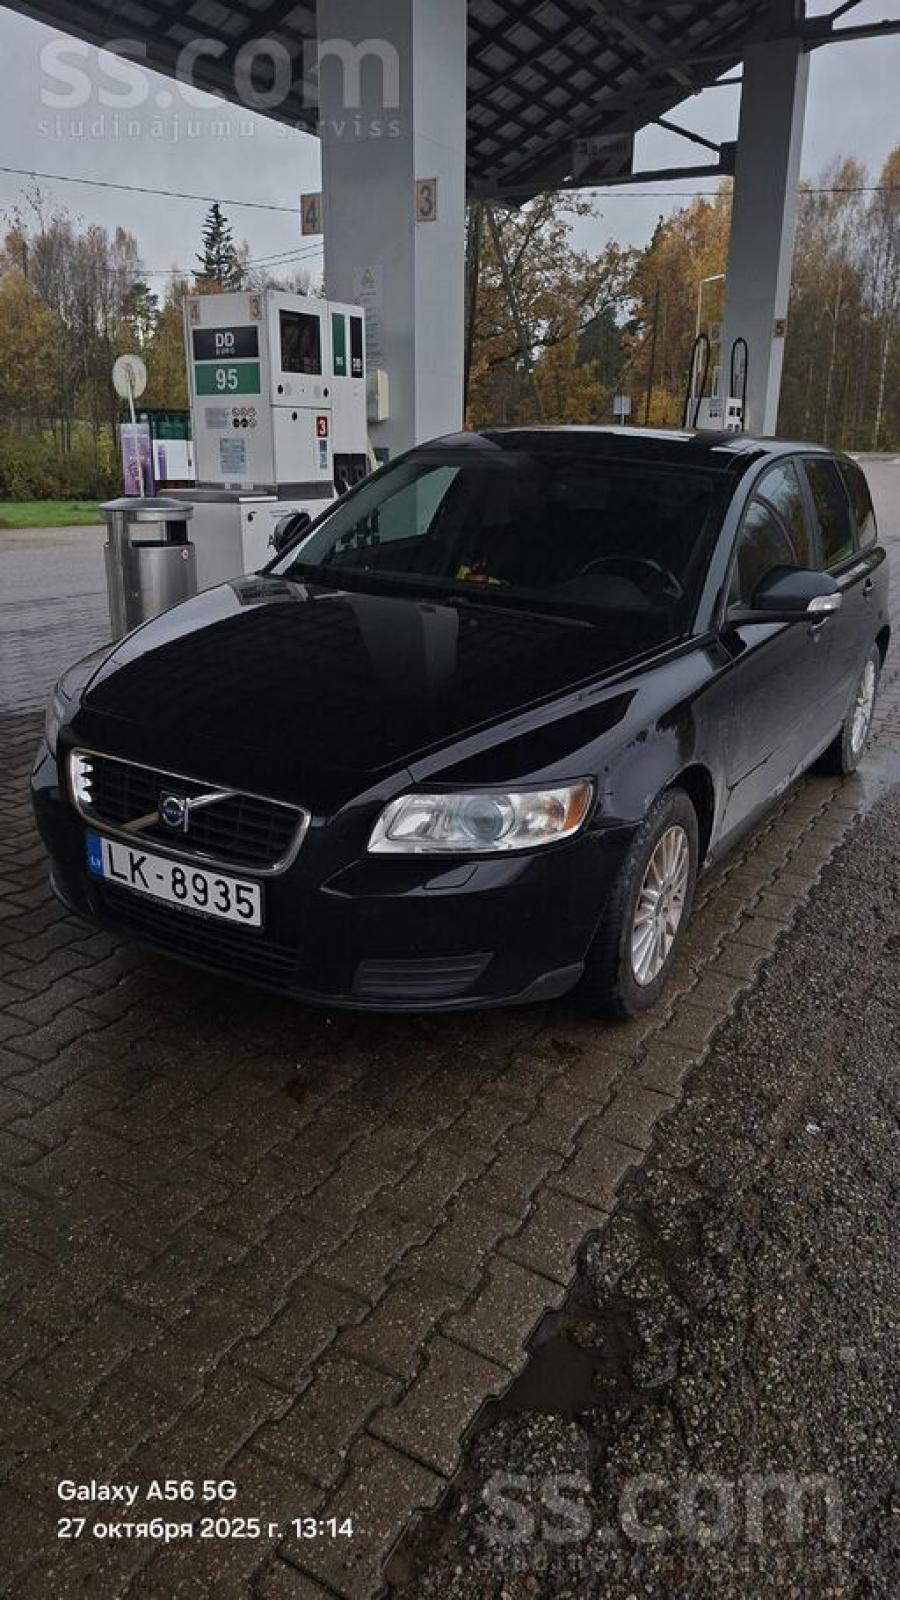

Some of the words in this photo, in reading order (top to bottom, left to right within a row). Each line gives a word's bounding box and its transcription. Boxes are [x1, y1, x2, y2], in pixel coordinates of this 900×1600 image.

[305, 198, 318, 228] 4
[420, 186, 432, 217] 3
[215, 332, 235, 347] DD
[215, 368, 238, 390] 95
[319, 419, 326, 435] 3
[107, 843, 254, 919] LK-8935
